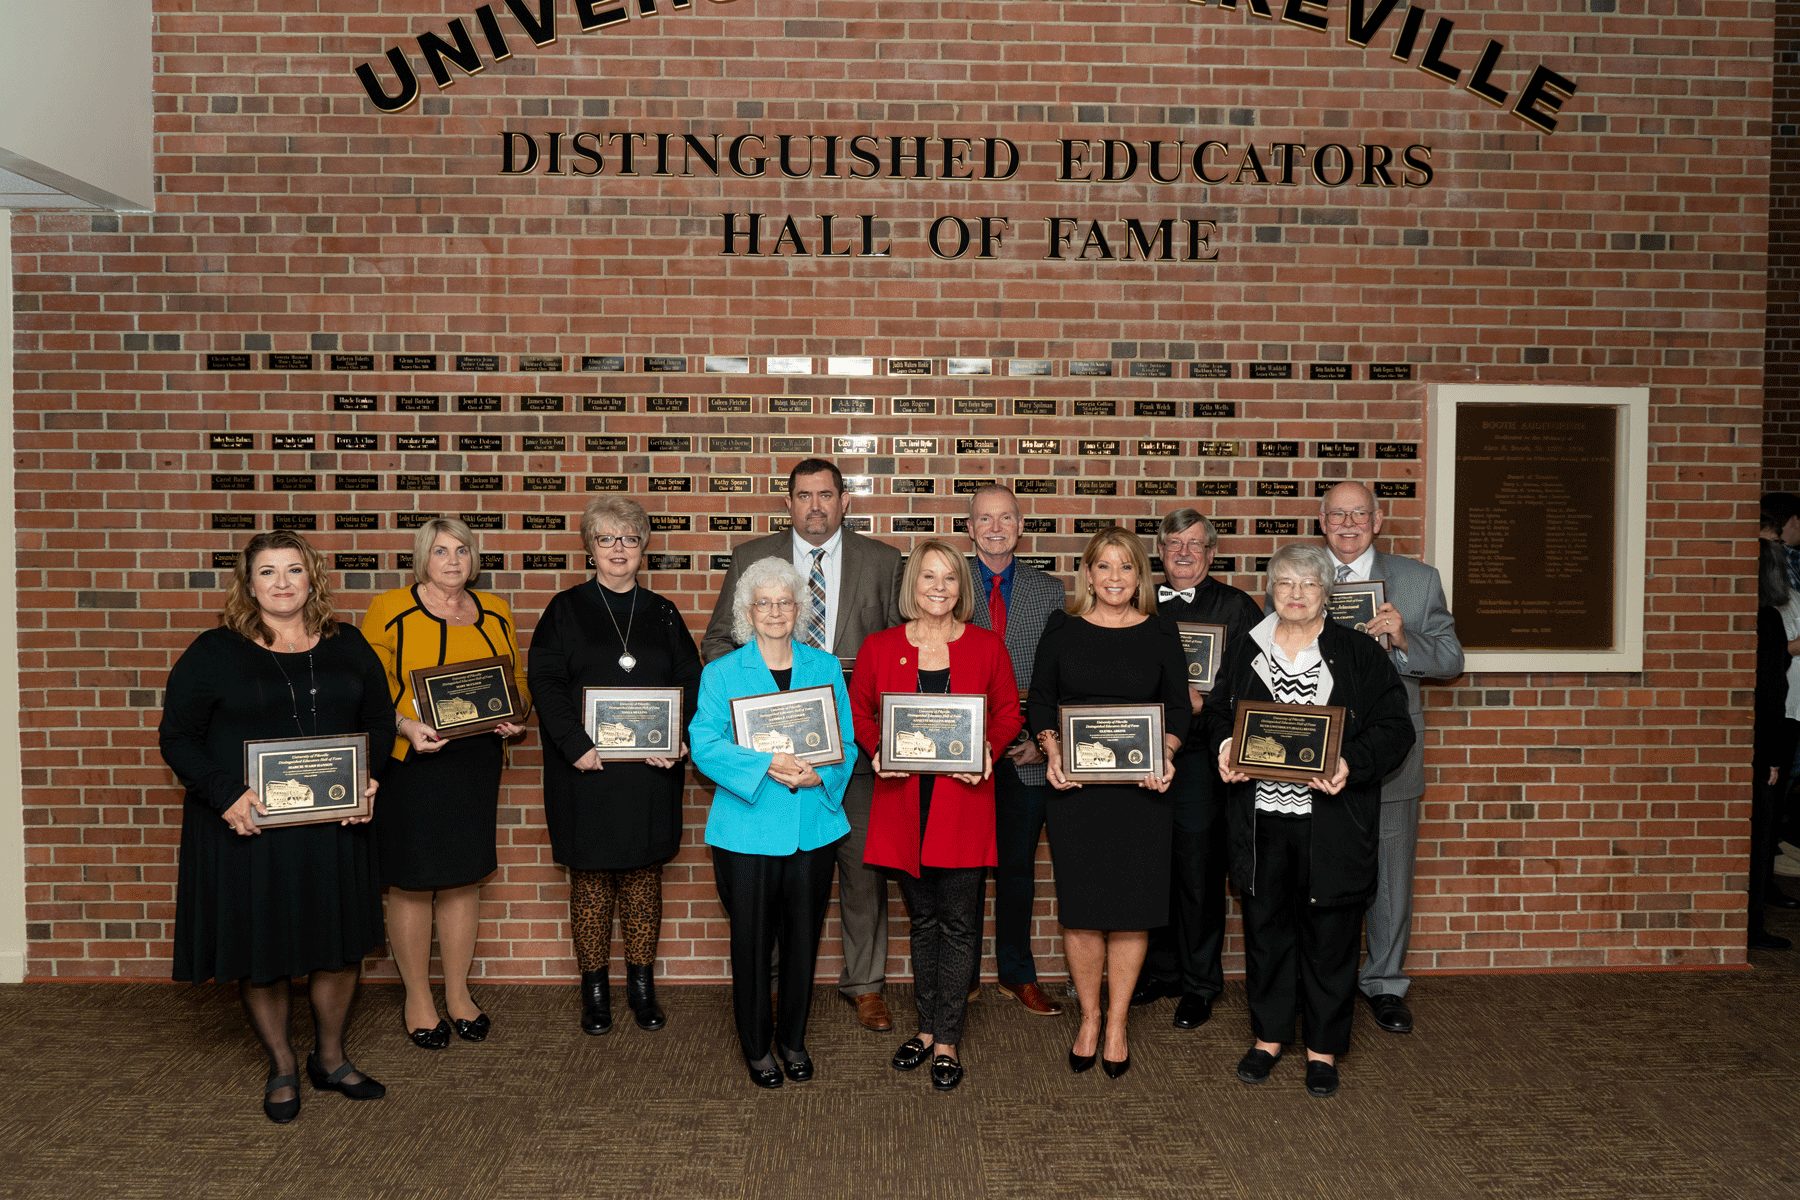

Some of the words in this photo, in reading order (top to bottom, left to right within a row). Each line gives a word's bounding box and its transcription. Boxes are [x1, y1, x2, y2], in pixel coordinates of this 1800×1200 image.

[355, 0, 737, 112] UNIVE
[1189, 0, 1578, 136] EVILLE
[498, 130, 1021, 182] DISTINGUISHED
[1056, 137, 1435, 188] EDUCATORS
[718, 212, 892, 258] HALL
[927, 215, 1010, 261] OF
[1043, 216, 1220, 263] FAME
